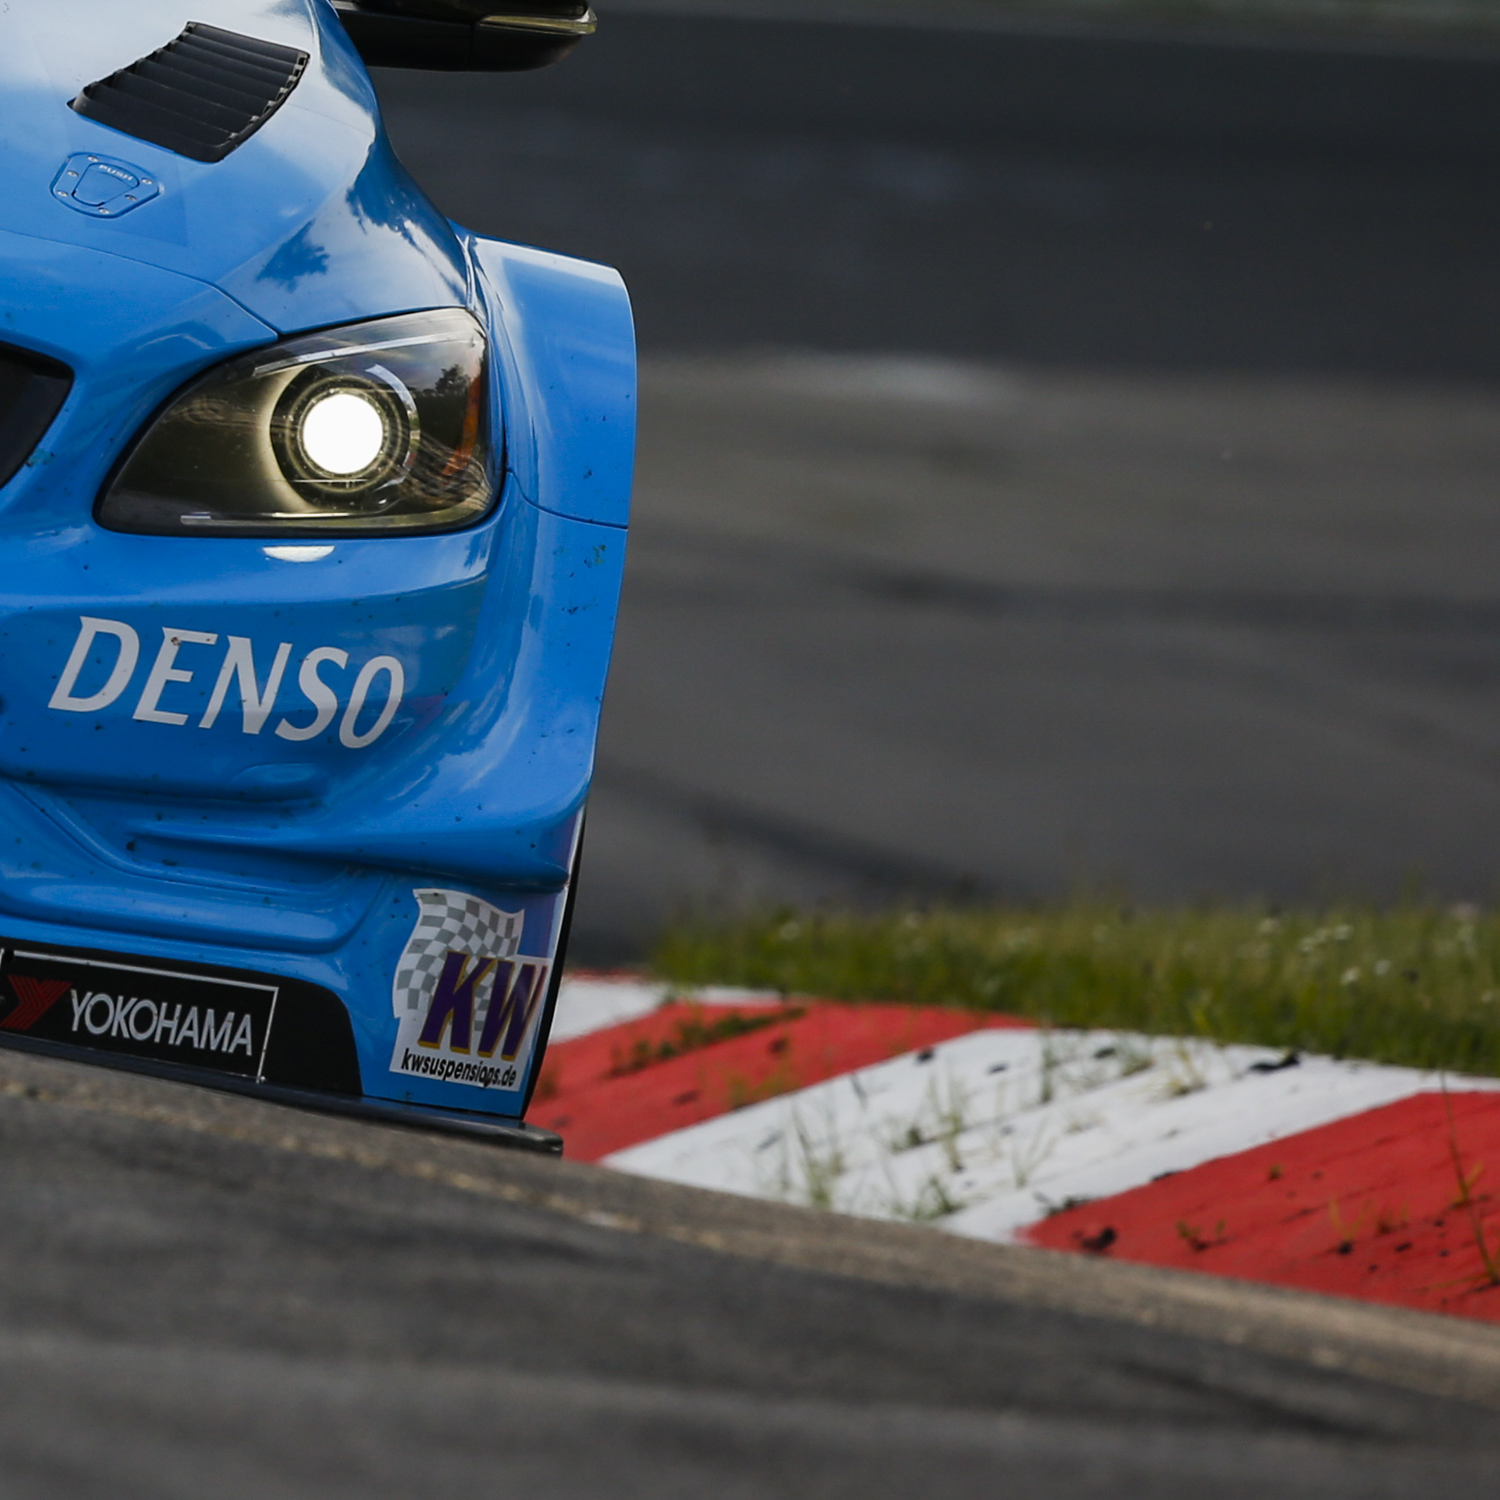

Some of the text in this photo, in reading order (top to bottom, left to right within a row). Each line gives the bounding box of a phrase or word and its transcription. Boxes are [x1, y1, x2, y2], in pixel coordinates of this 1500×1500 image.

[98, 164, 134, 181] PUSH
[47, 616, 405, 749] DENSO
[70, 988, 253, 1057] YOKOHAMA
[417, 950, 549, 1062] KW
[401, 1048, 517, 1088] kwsuspensions.de
